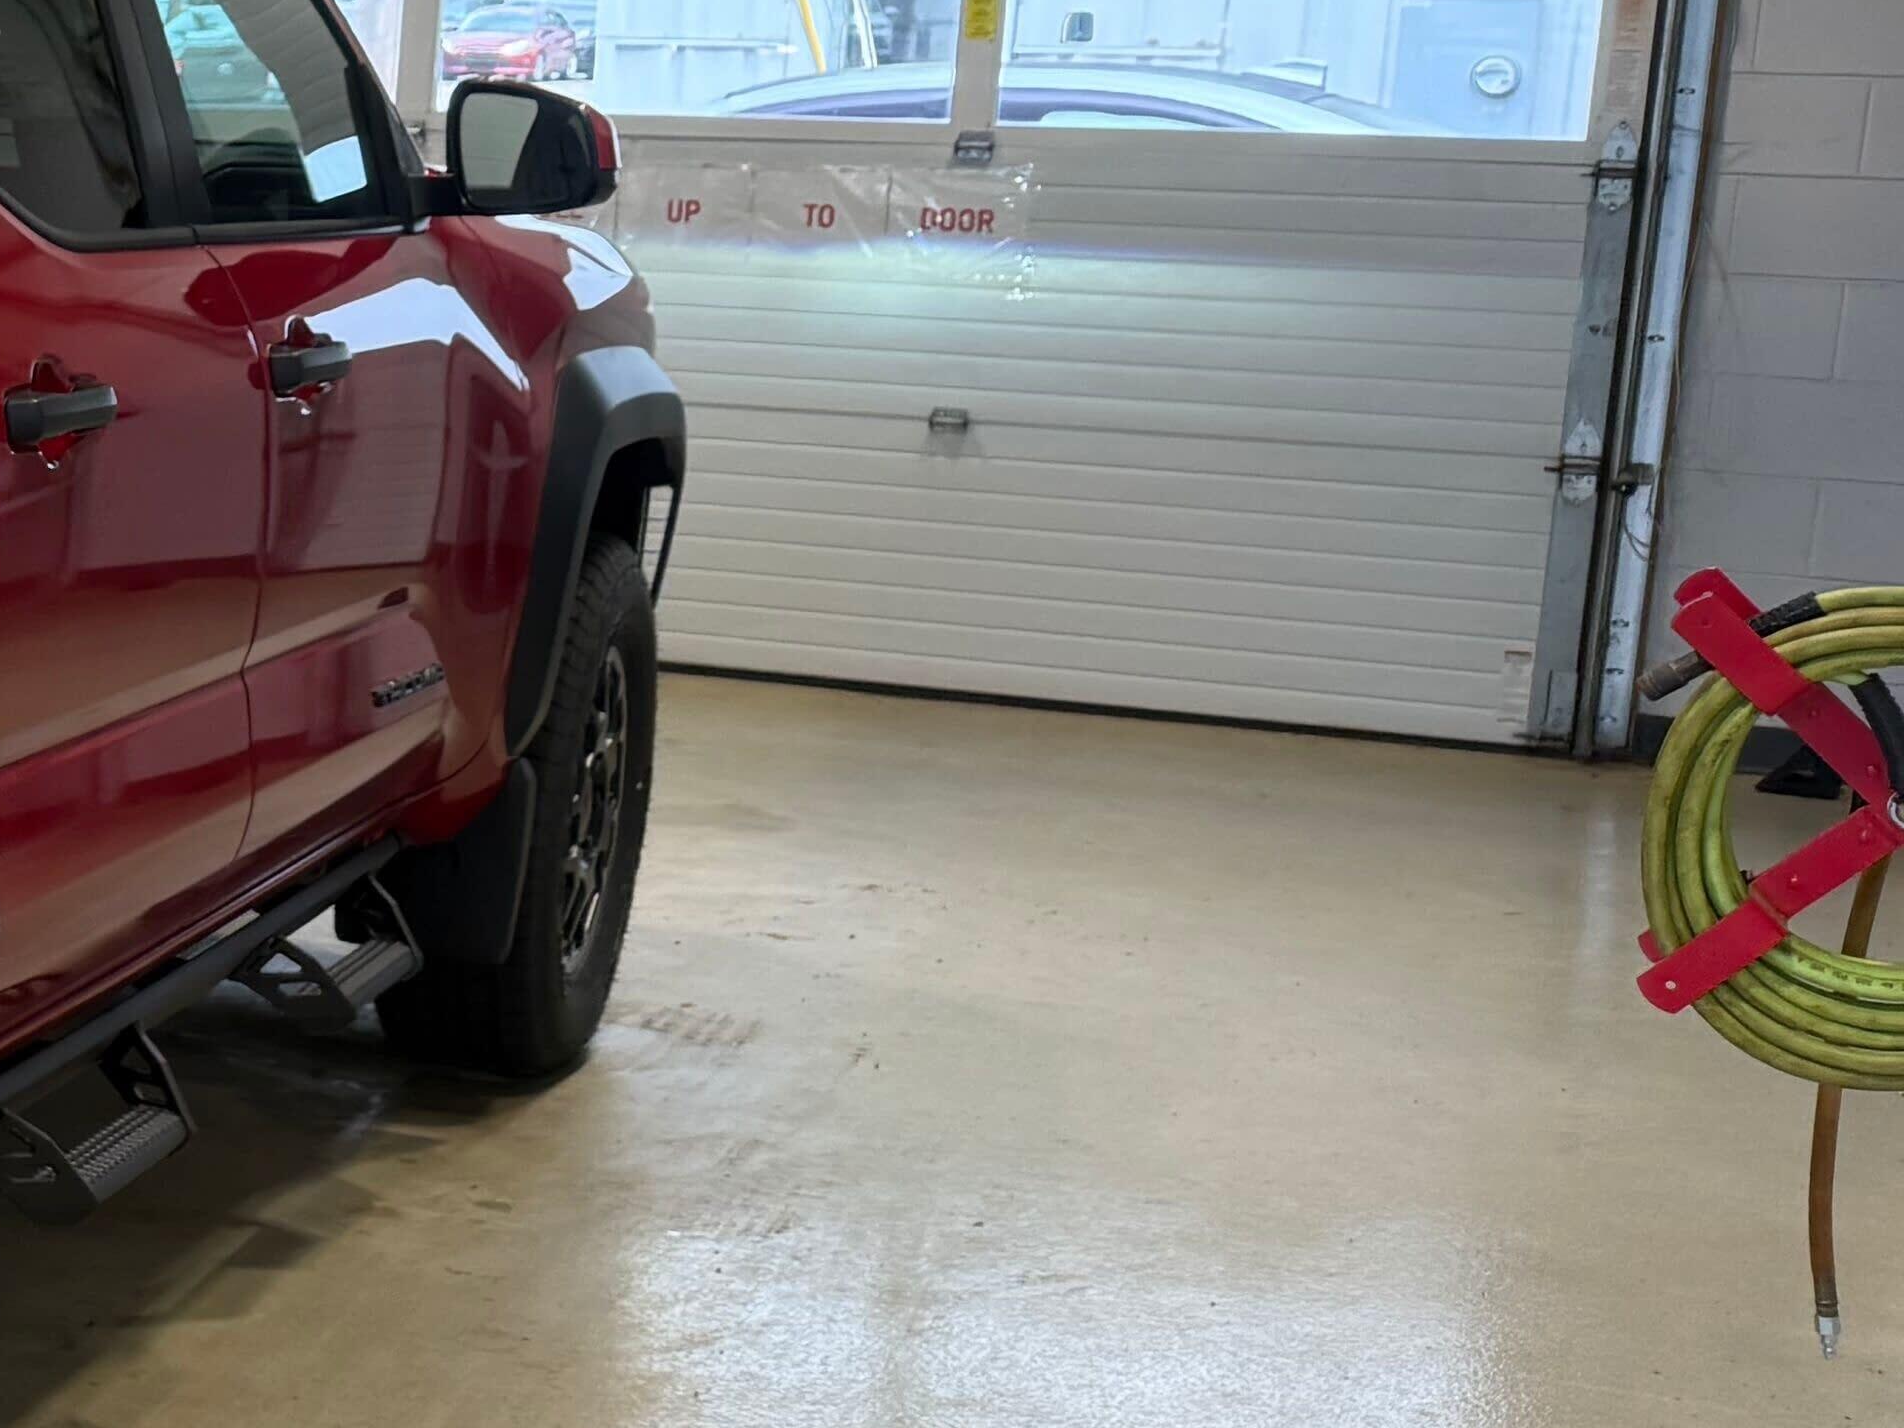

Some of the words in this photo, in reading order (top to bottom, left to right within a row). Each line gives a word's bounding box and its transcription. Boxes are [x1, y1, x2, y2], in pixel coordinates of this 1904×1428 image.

[666, 199, 701, 224] UP
[803, 203, 836, 229] TO
[919, 207, 995, 233] DOOR
